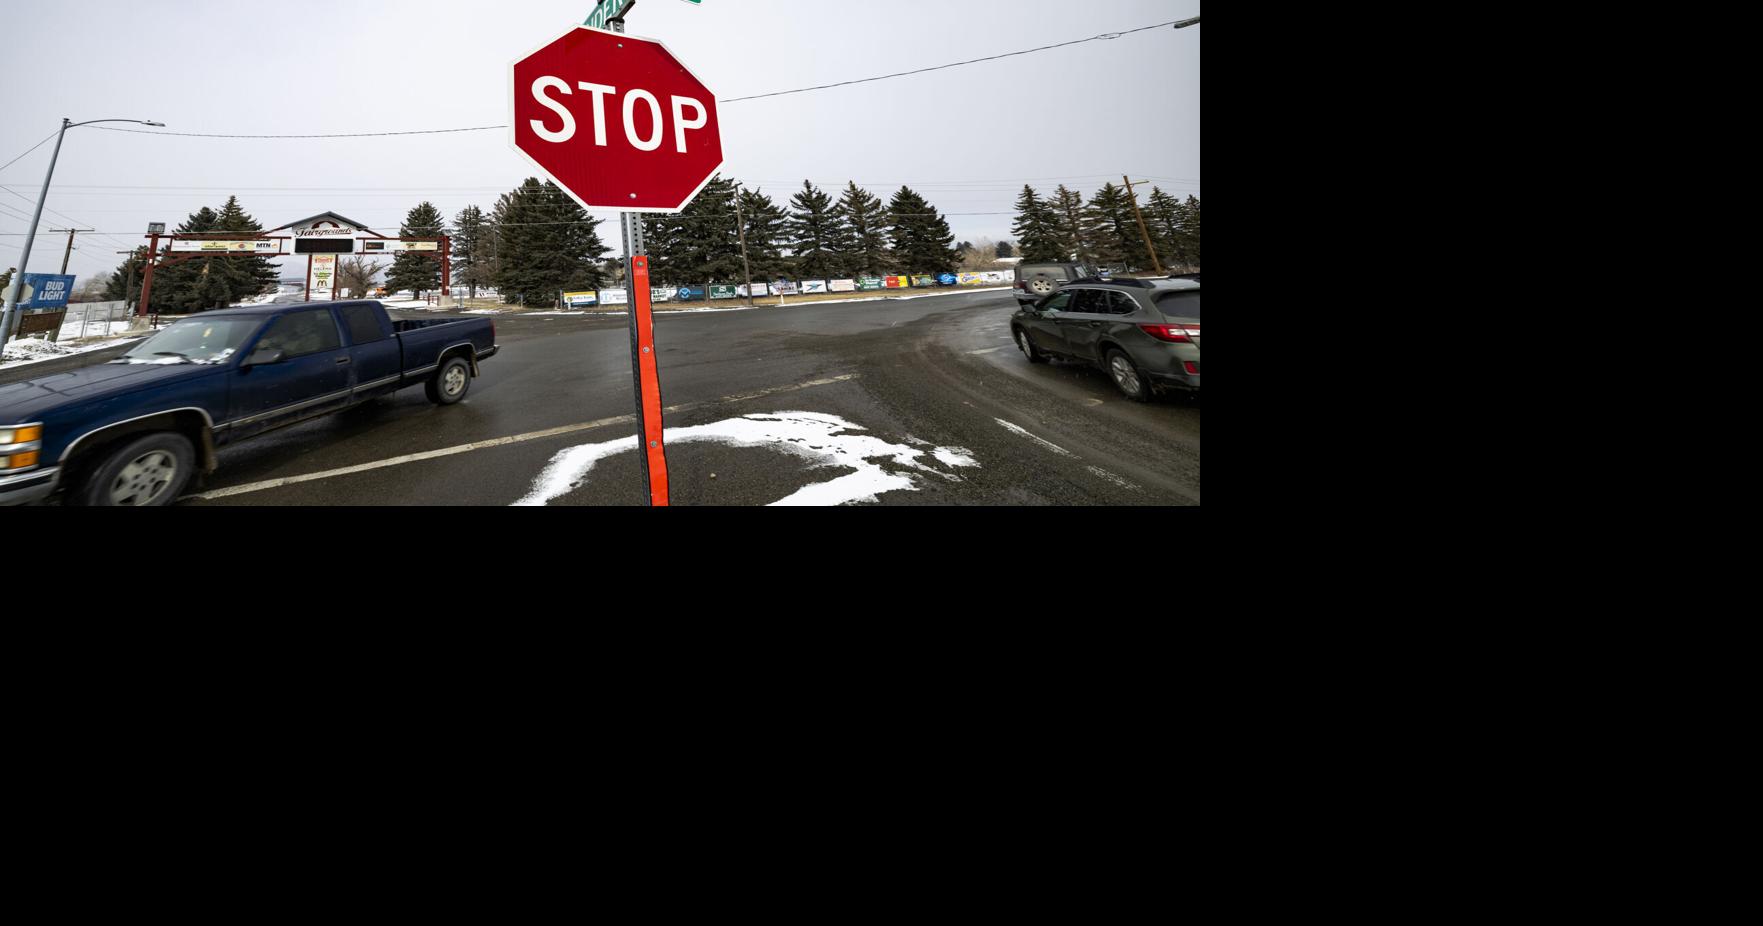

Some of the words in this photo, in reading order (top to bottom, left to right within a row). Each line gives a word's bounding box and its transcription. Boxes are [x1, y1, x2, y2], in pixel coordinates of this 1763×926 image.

[529, 75, 708, 154] STOP
[294, 227, 352, 237] Fairgrounds
[45, 281, 65, 290] BUD
[38, 291, 65, 300] LIGHT
